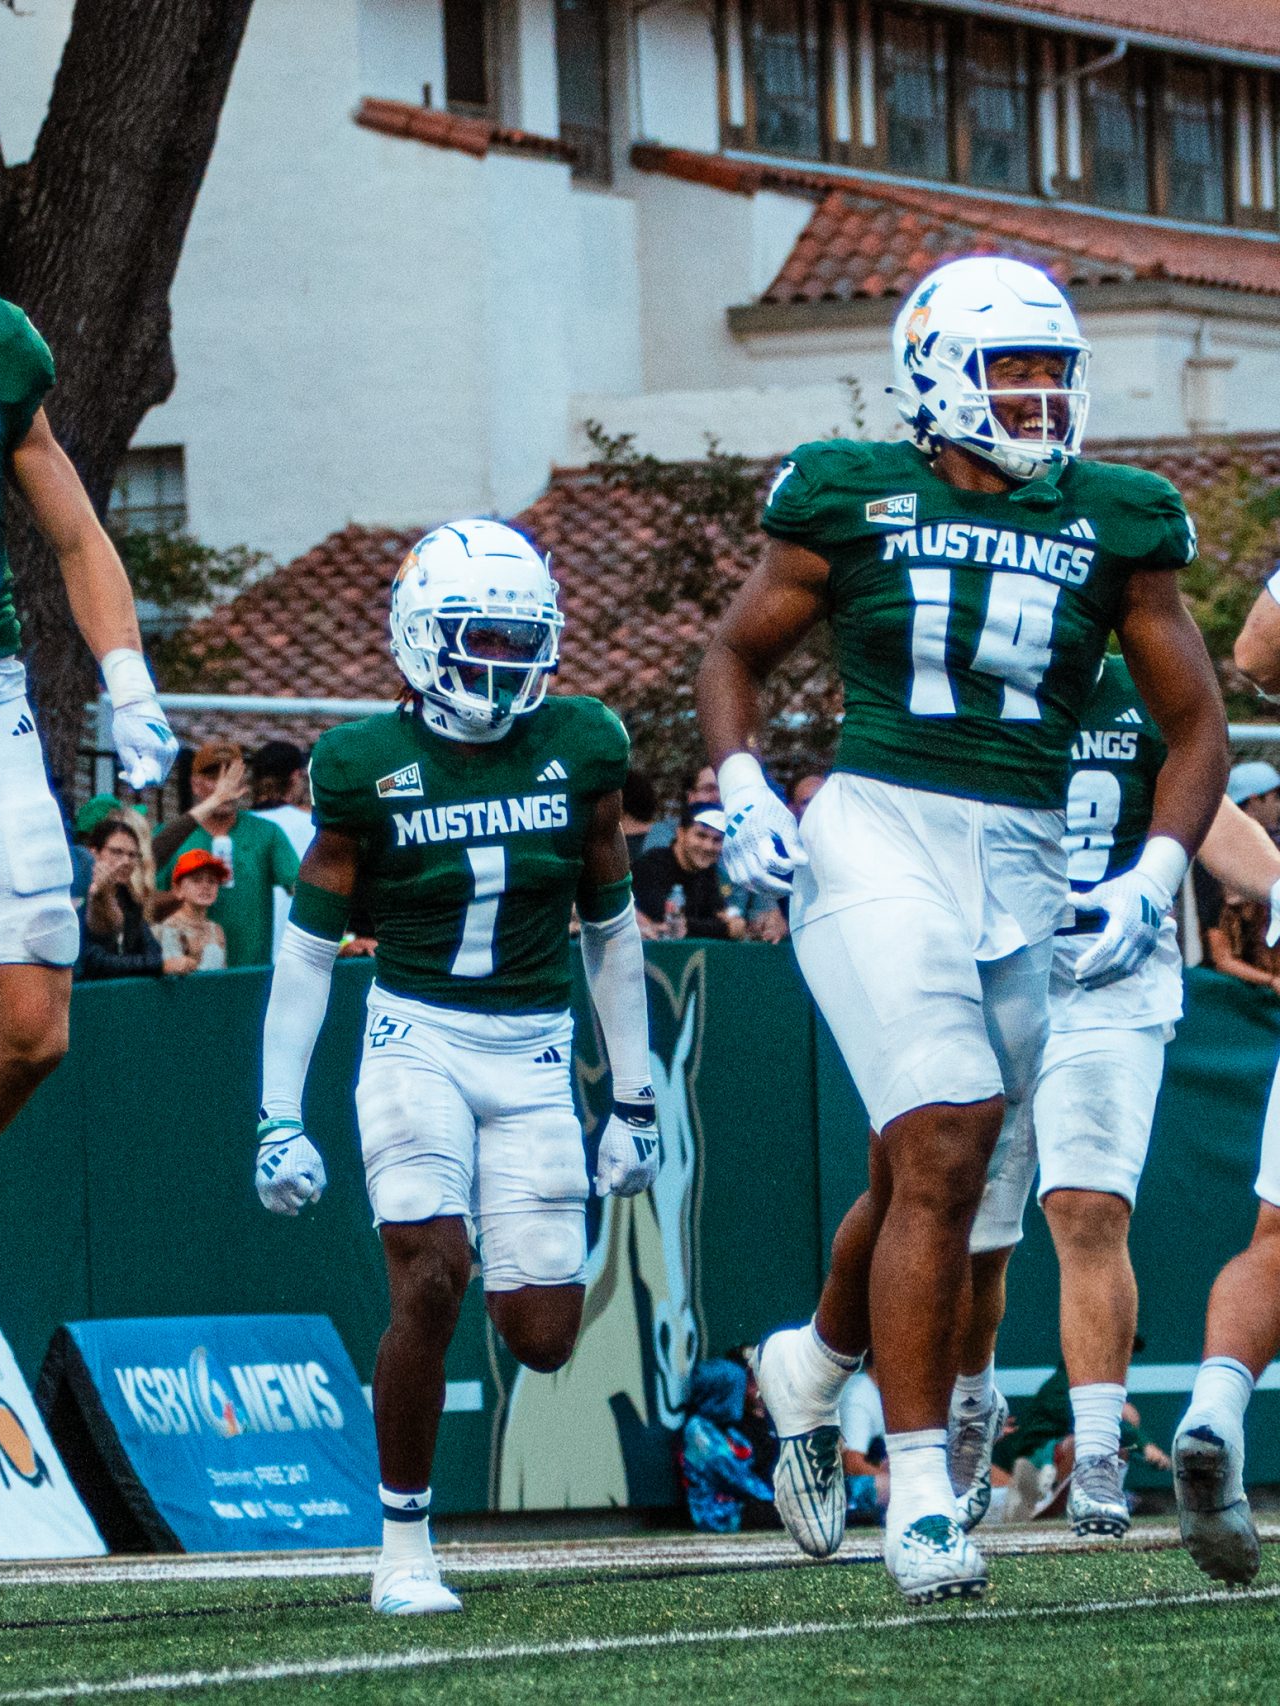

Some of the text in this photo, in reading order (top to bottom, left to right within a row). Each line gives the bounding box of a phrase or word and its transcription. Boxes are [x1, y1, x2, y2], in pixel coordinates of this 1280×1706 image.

[883, 522, 1095, 585] MUSTANGS
[908, 567, 1062, 721] 14
[392, 794, 568, 846] MUSTANGS
[450, 845, 506, 979] 1
[114, 1366, 202, 1435] KSBY
[230, 1360, 345, 1435] NEWS
